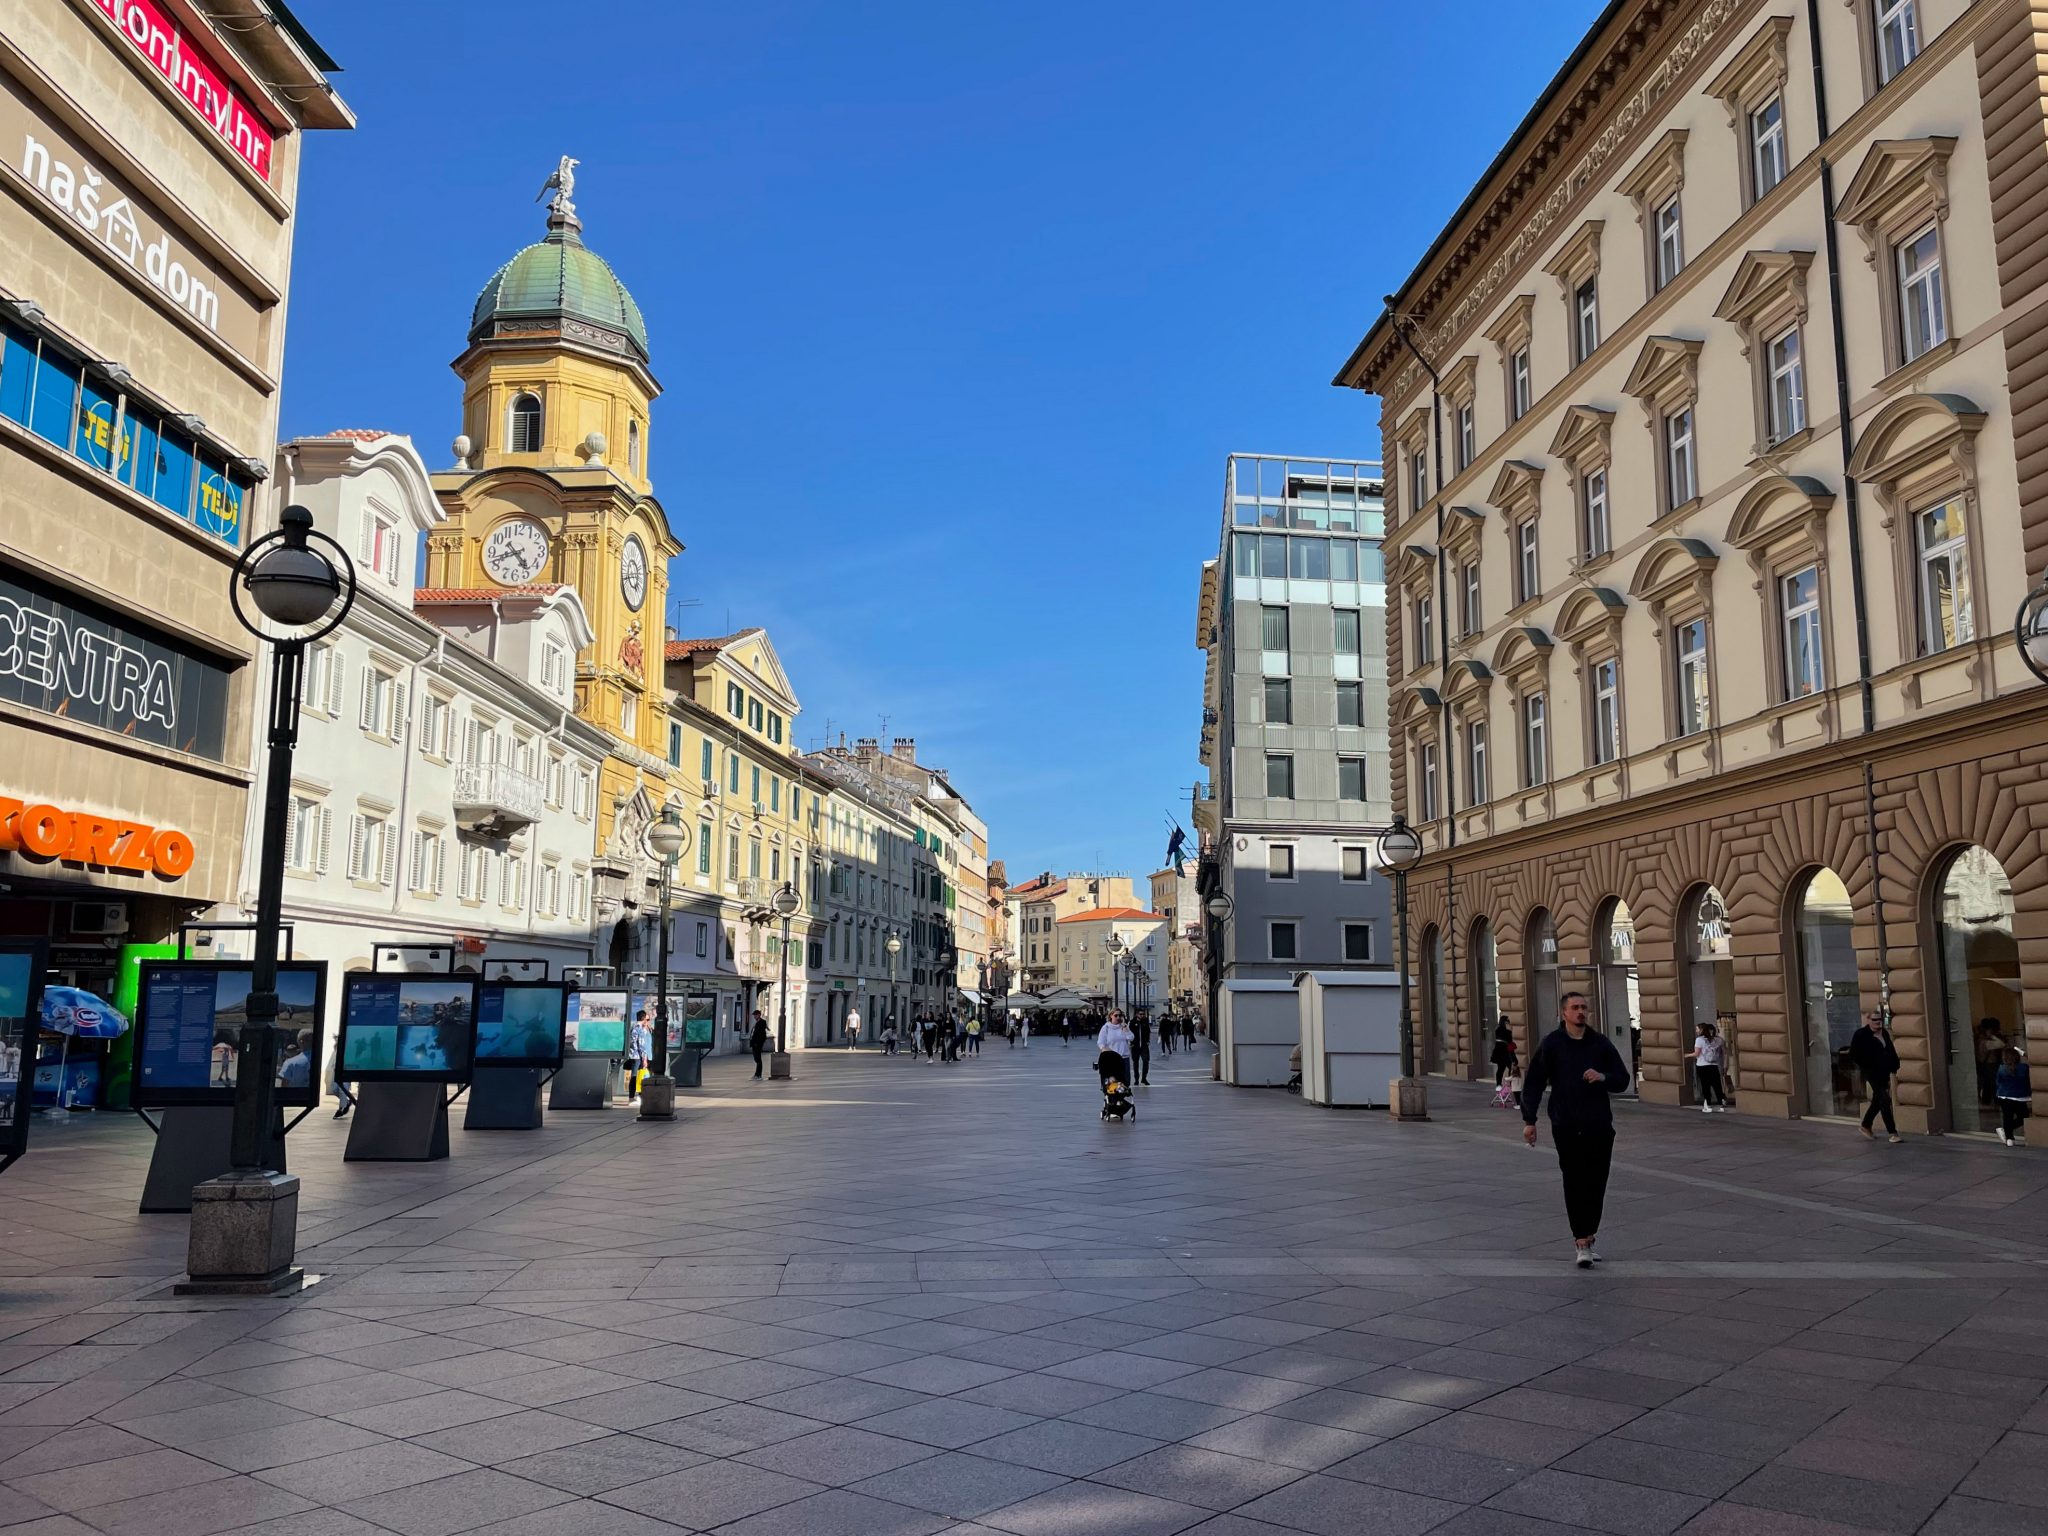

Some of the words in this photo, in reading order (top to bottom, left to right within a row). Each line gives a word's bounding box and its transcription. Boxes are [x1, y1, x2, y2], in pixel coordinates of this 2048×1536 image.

[23, 134, 102, 230] naš
[145, 234, 219, 332] dom
[201, 482, 239, 526] TEDi
